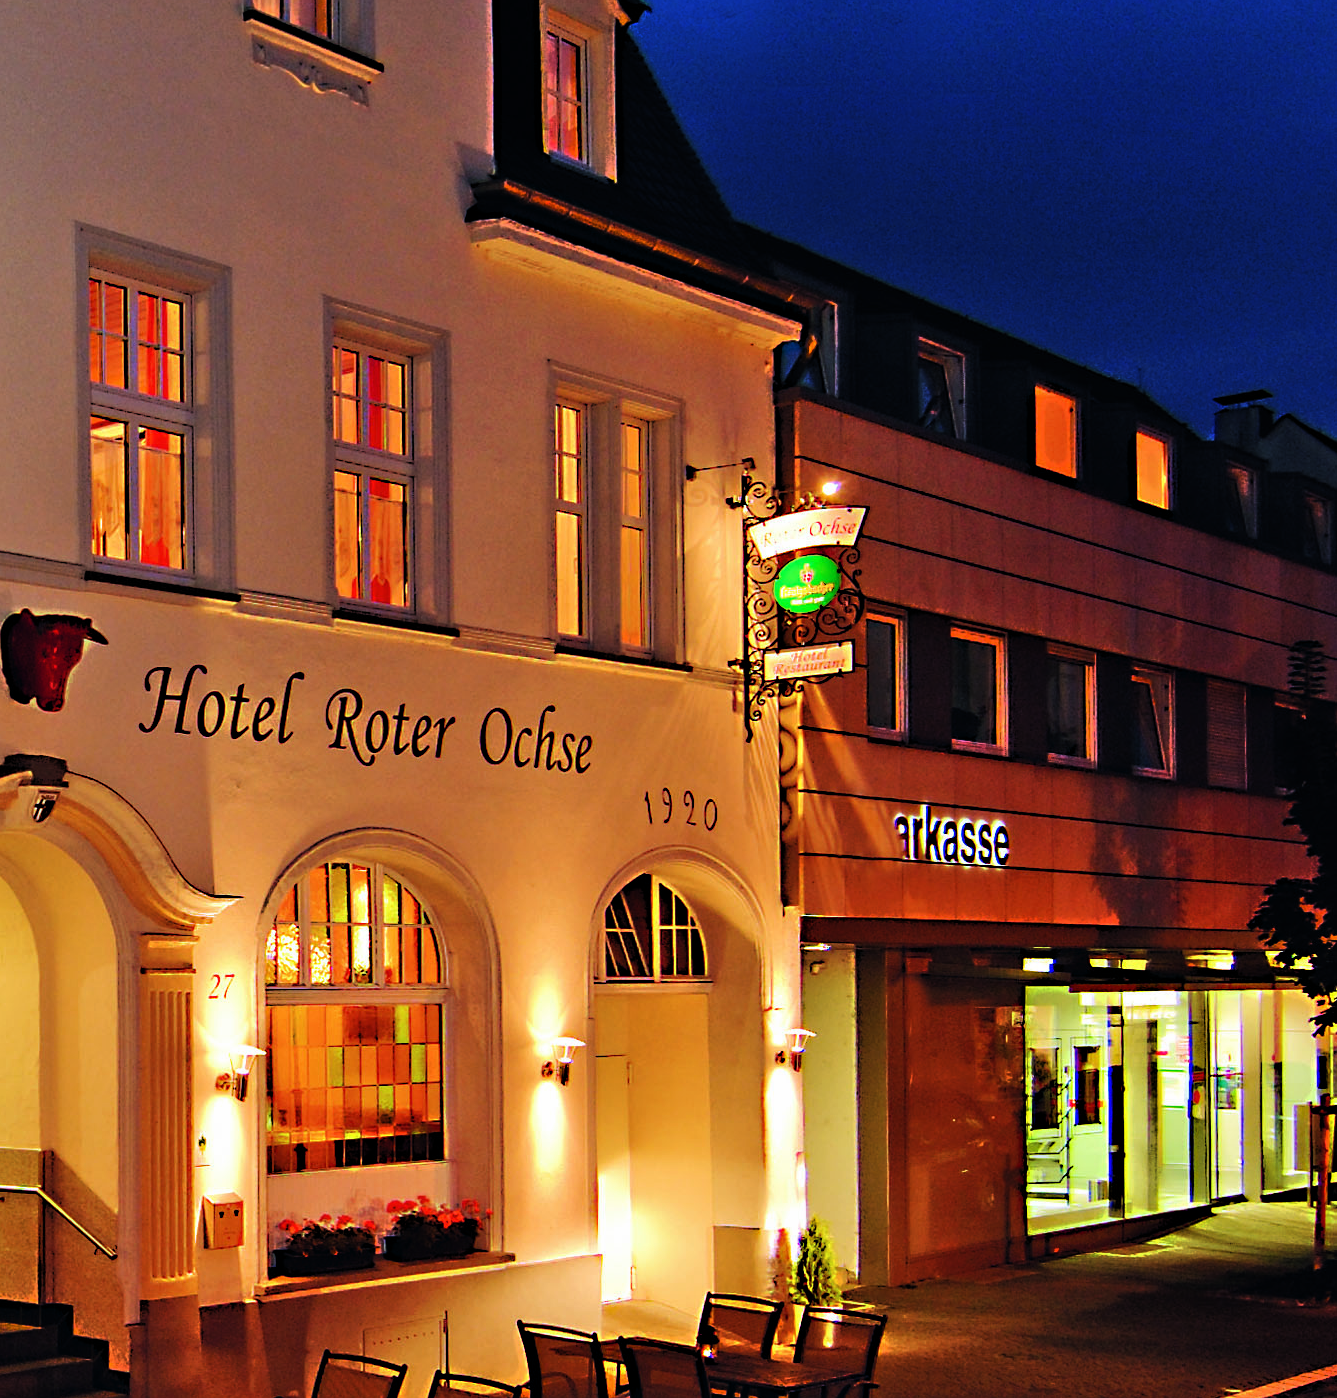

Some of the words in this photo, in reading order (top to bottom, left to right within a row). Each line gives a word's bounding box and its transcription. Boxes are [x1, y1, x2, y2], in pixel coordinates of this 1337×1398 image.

[808, 517, 857, 537] Ochse
[790, 647, 827, 662] Hotel
[773, 659, 845, 676] Restaurant
[138, 664, 305, 745] Hotel
[325, 688, 456, 767] Roter
[479, 704, 593, 774] Ochse
[644, 787, 718, 832] 1920
[893, 803, 1010, 866] arkasse
[208, 974, 235, 999] 27
